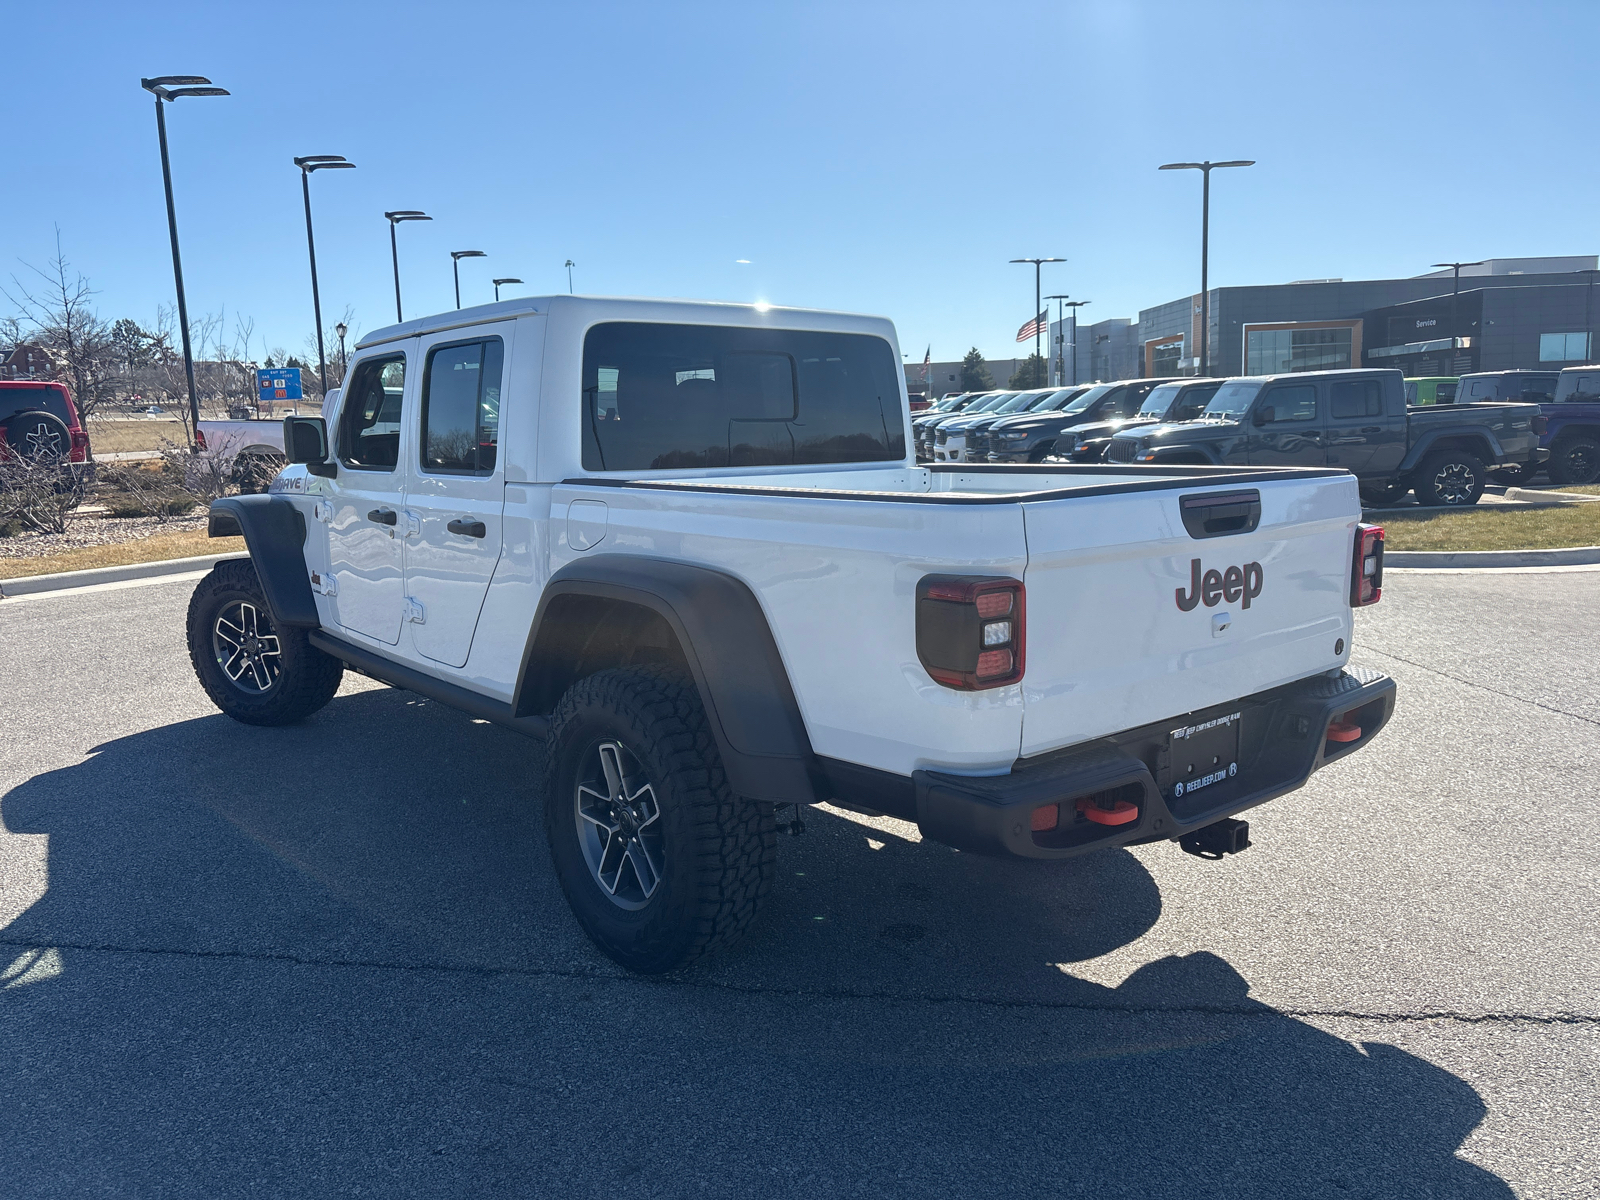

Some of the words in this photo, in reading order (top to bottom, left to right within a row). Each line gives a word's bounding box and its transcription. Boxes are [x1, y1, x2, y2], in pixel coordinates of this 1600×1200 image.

[1416, 319, 1437, 328] Service
[1175, 558, 1263, 612] Jeep
[1186, 769, 1227, 793] REEDJEEP.COM
